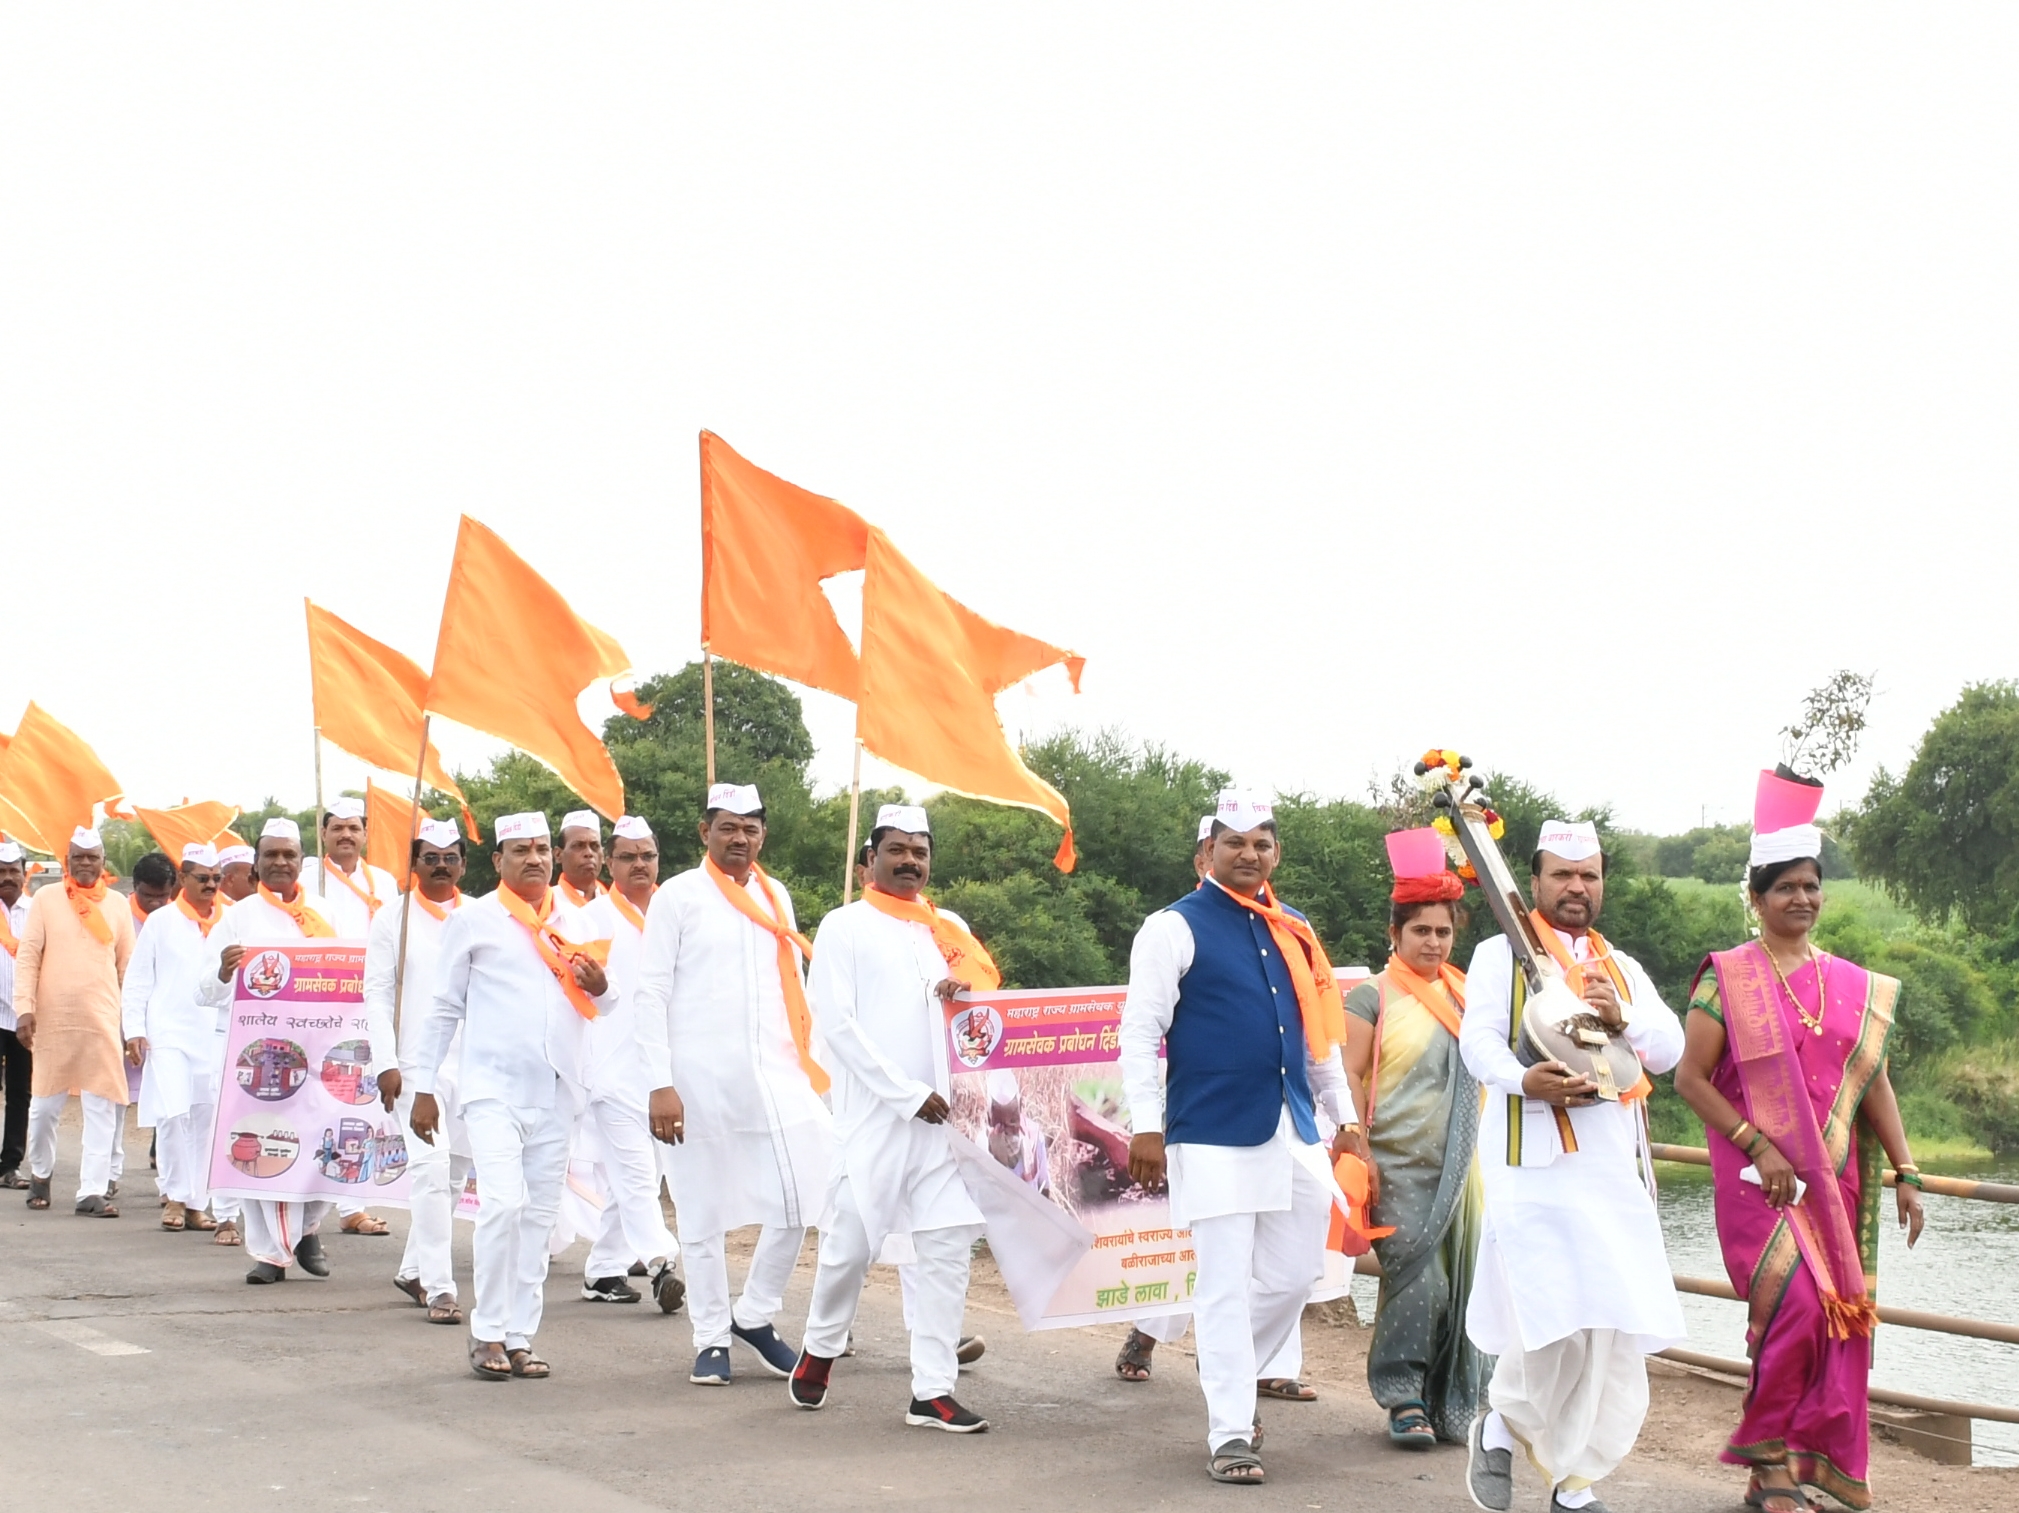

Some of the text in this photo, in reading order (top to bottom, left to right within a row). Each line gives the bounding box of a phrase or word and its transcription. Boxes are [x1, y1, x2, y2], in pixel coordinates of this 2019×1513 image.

[294, 973, 338, 993] ग्रामसेवक
[1043, 1004, 1066, 1016] राज्य
[1069, 1000, 1115, 1015] ग्रामसेवक
[238, 1012, 278, 1027] शालेय
[1004, 1030, 1056, 1057] ग्रामसेवक
[1058, 1027, 1096, 1054] प्रबोधन
[1096, 1280, 1130, 1308] झाडे
[1135, 1282, 1169, 1303] लावा
